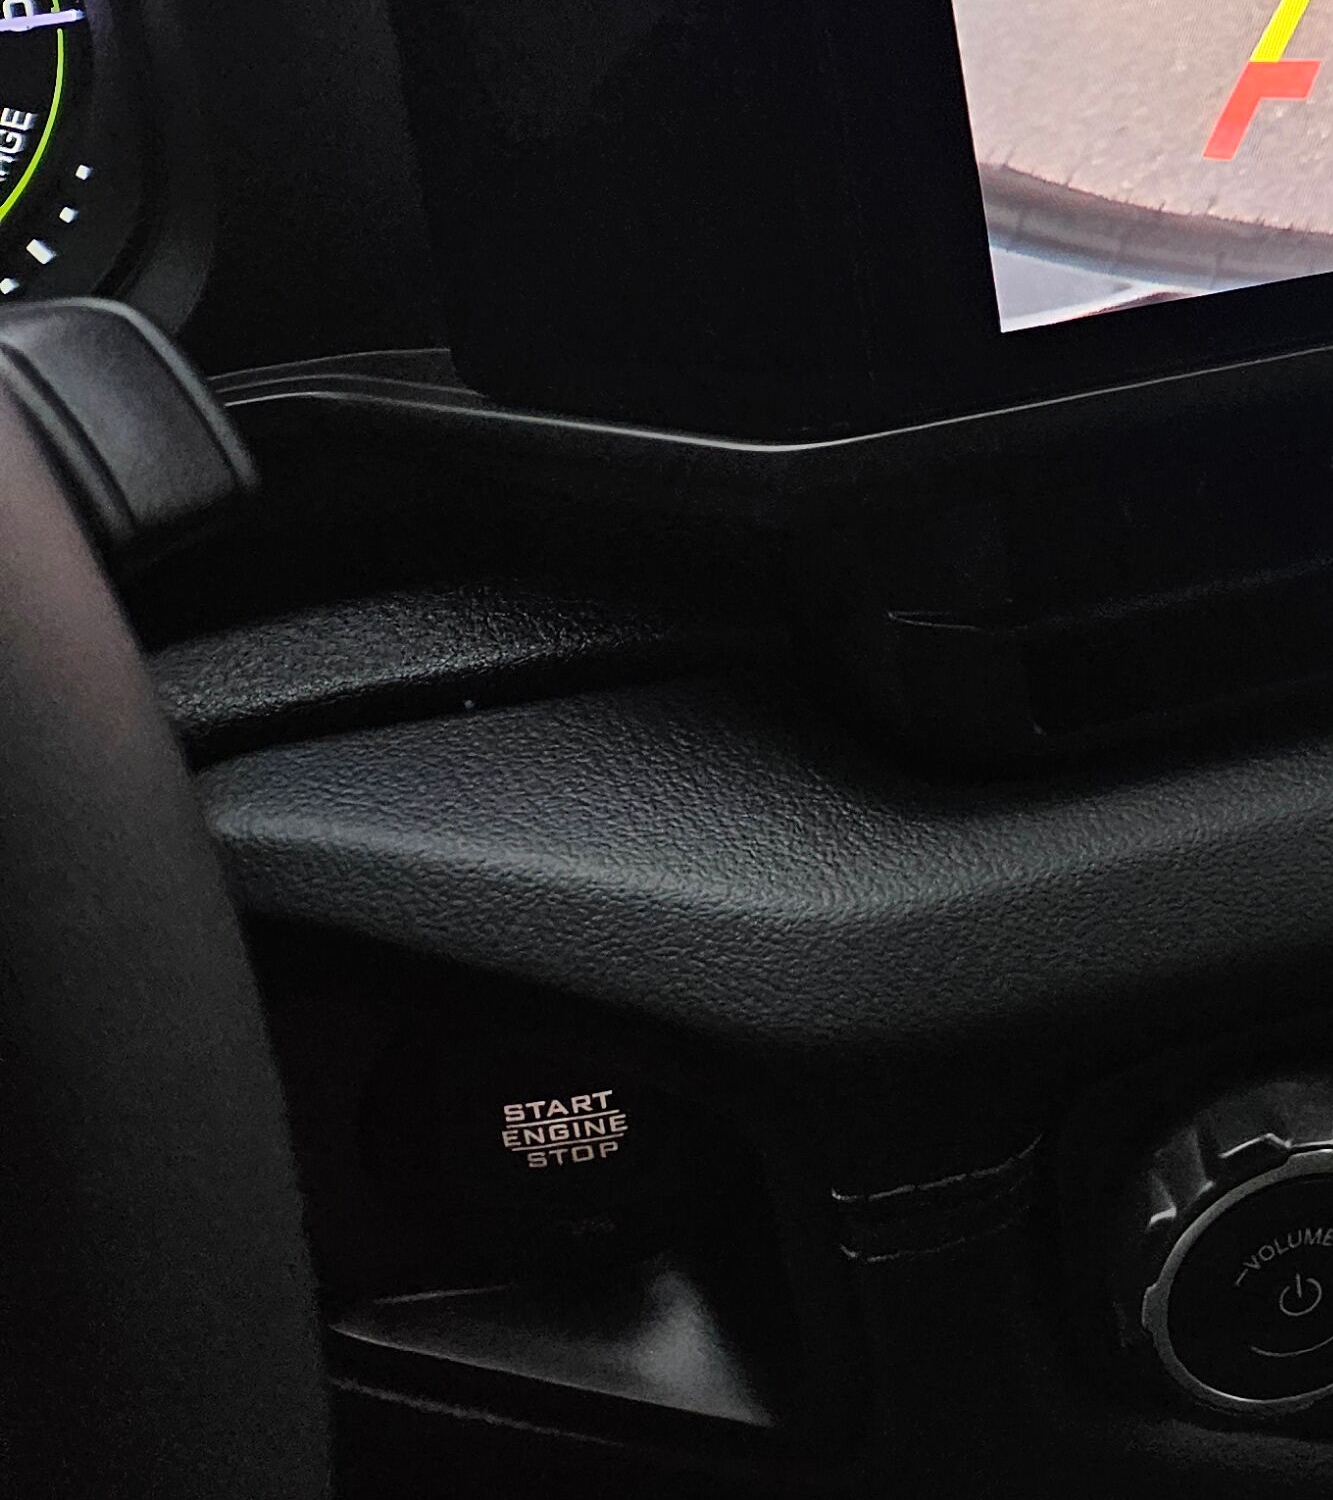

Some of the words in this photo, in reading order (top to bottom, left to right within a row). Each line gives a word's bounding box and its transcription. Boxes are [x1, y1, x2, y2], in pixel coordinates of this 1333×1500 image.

[503, 1089, 613, 1123] START
[502, 1113, 628, 1148] ENGINE
[527, 1140, 619, 1168] STOP
